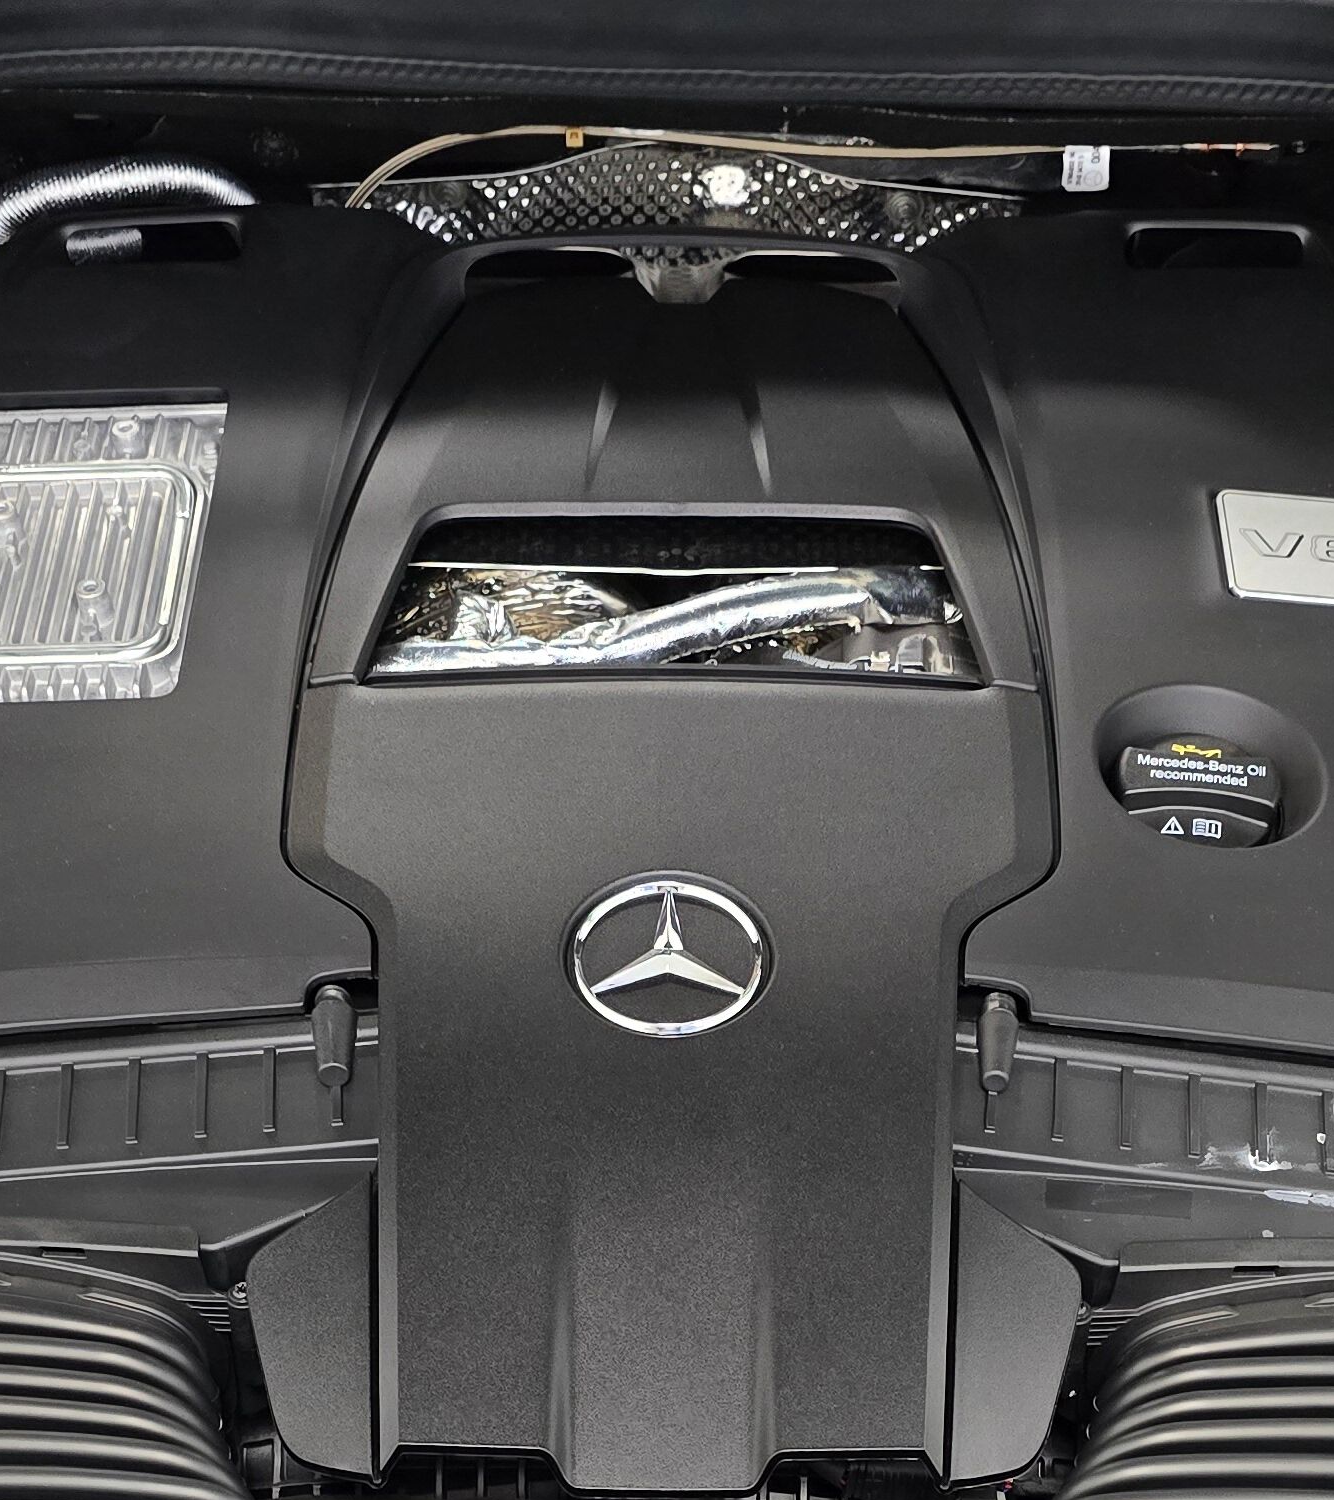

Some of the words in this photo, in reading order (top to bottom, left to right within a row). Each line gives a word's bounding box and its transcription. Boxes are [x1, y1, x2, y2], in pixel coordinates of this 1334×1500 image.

[1137, 754, 1244, 774] Mercedes-Benz
[1247, 765, 1266, 777] Oil
[1150, 768, 1248, 787] recommended
